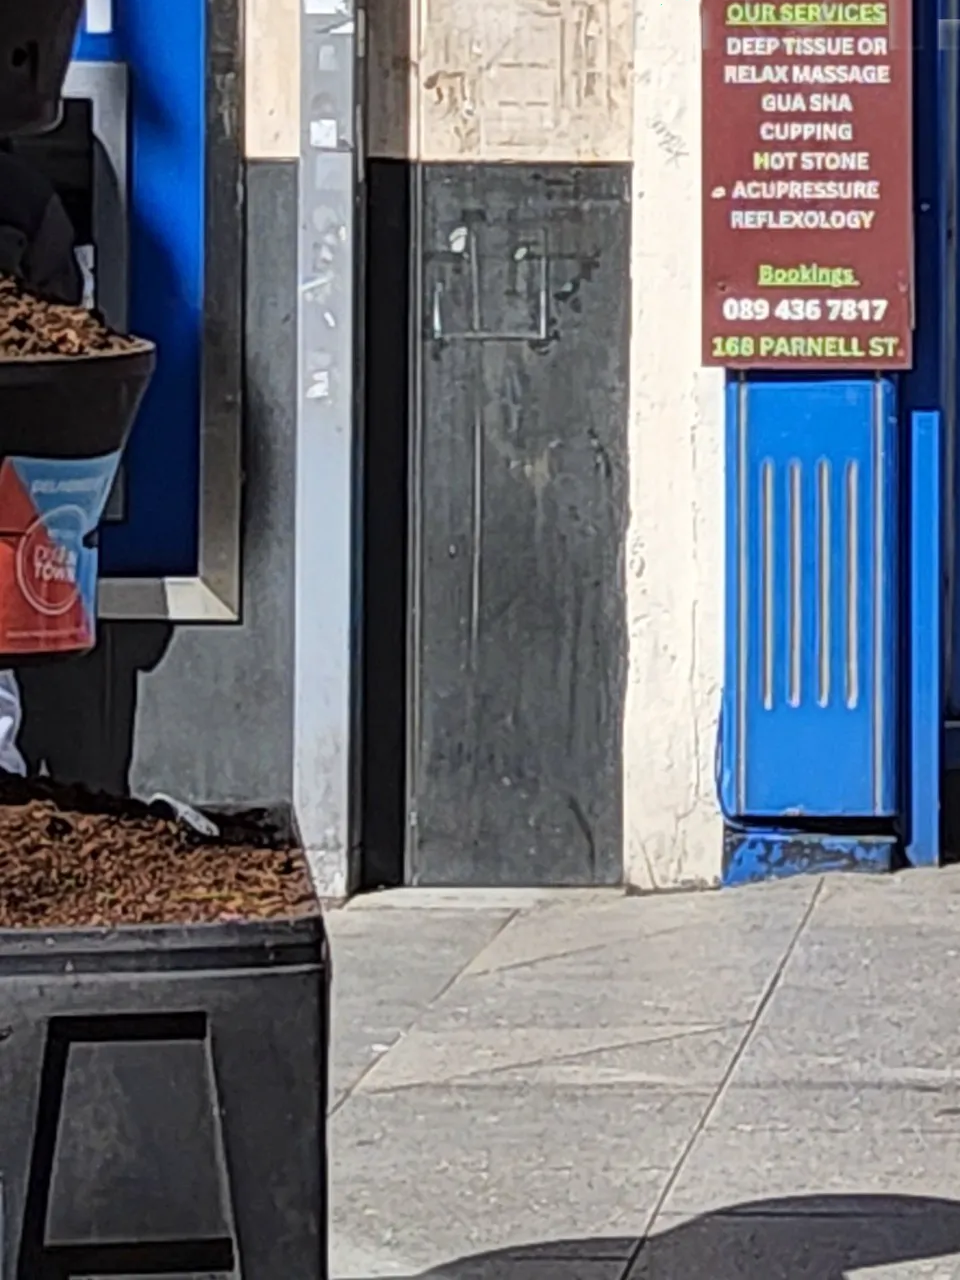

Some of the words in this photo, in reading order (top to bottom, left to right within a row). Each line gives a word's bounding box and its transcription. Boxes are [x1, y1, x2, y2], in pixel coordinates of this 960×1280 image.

[726, 2, 776, 24] OUR
[779, 2, 888, 24] SERVICES
[726, 36, 780, 56] DEEP
[782, 36, 854, 56] TISSUE
[857, 36, 888, 56] OR
[724, 65, 789, 84] RELAX
[792, 65, 891, 84] MASSAGE
[761, 93, 806, 112] GUA
[809, 93, 853, 112] SHA
[759, 122, 853, 141] CUPPING
[753, 151, 797, 171] HOT
[800, 151, 870, 171] STONE
[732, 180, 880, 199] ACUPRESSURE
[730, 210, 875, 229] REFLEXOLOGY
[722, 298, 769, 321] 089
[773, 298, 821, 321] 436
[826, 298, 888, 321] 7817
[712, 336, 754, 357] 168
[759, 336, 866, 357] PARNELL
